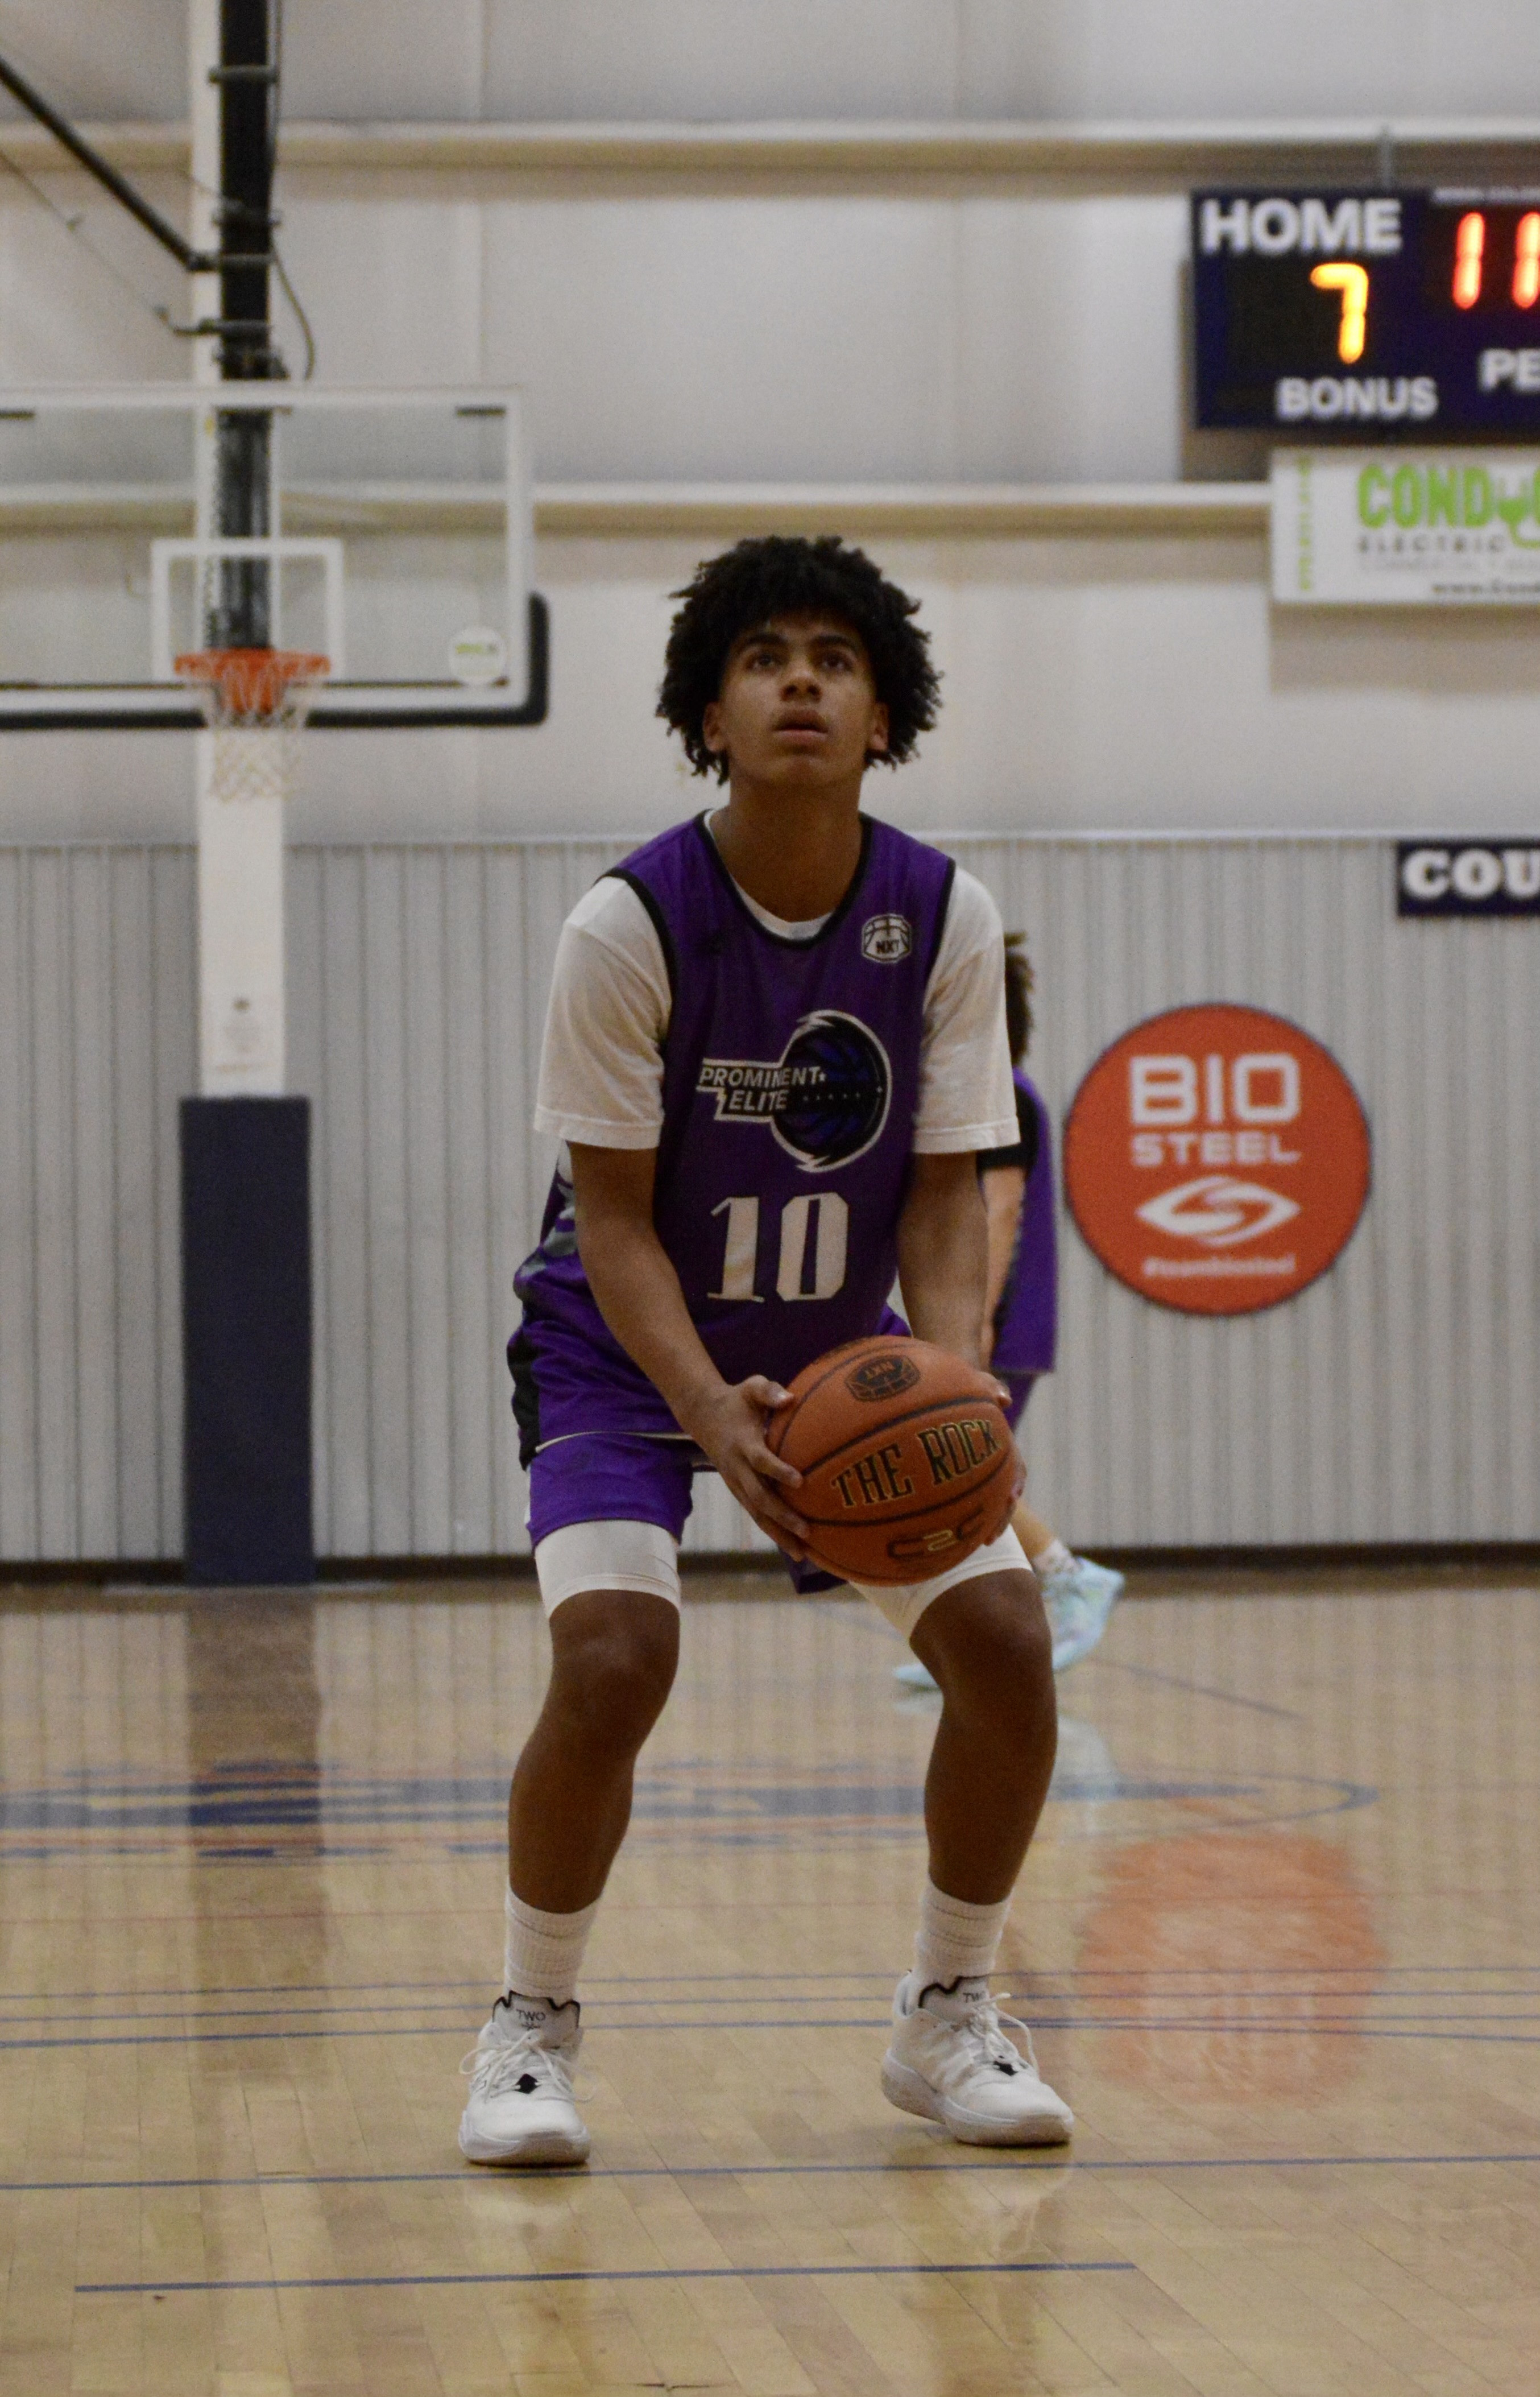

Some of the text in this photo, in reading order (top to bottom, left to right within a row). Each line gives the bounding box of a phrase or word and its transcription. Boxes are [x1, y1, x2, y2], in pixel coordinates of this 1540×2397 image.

[1201, 197, 1402, 255] HOME
[1310, 263, 1369, 365] 7
[1275, 376, 1439, 422] BONUS
[1402, 848, 1540, 900] COU
[699, 1065, 821, 1088] PROMINENT
[728, 1089, 789, 1112] ELITE
[1130, 1052, 1301, 1126] BIO
[1131, 1131, 1302, 1168] STEEL
[707, 1192, 849, 1303] 10
[830, 1419, 1001, 1509] THE ROCK
[516, 2008, 547, 2021] TWO
[962, 1992, 985, 2003] TW
